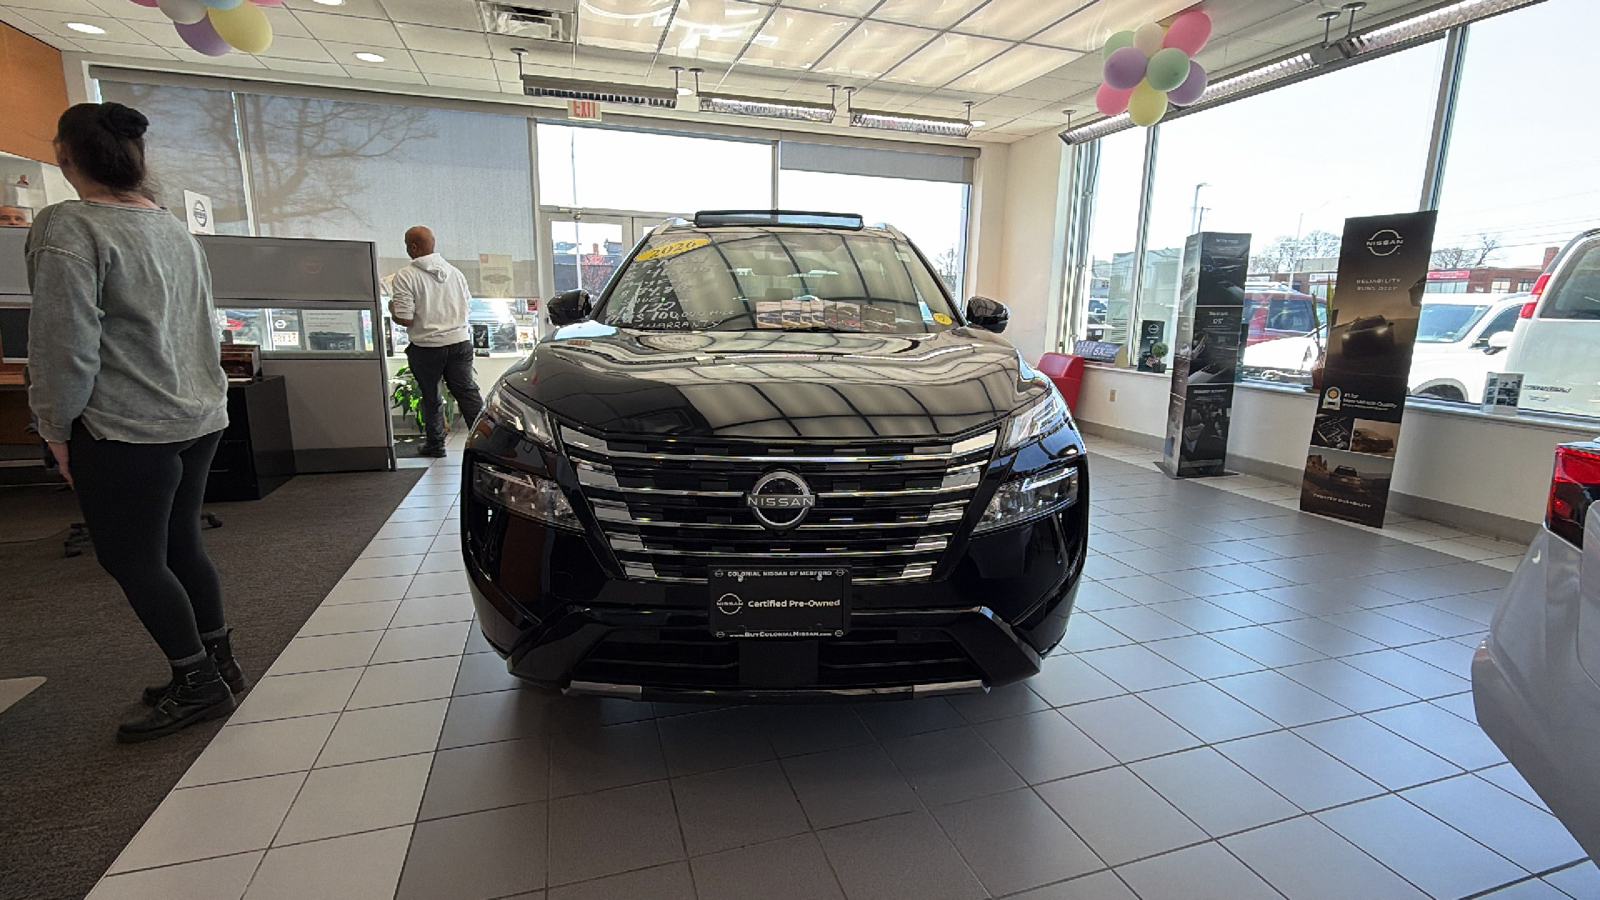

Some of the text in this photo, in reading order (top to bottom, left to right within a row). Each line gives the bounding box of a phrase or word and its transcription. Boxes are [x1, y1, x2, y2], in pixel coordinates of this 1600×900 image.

[573, 100, 595, 118] EXIT
[1366, 239, 1404, 247] NISSAN
[748, 495, 814, 507] NISSAN
[748, 600, 787, 608] Certified
[789, 599, 840, 608] Pre-Owned
